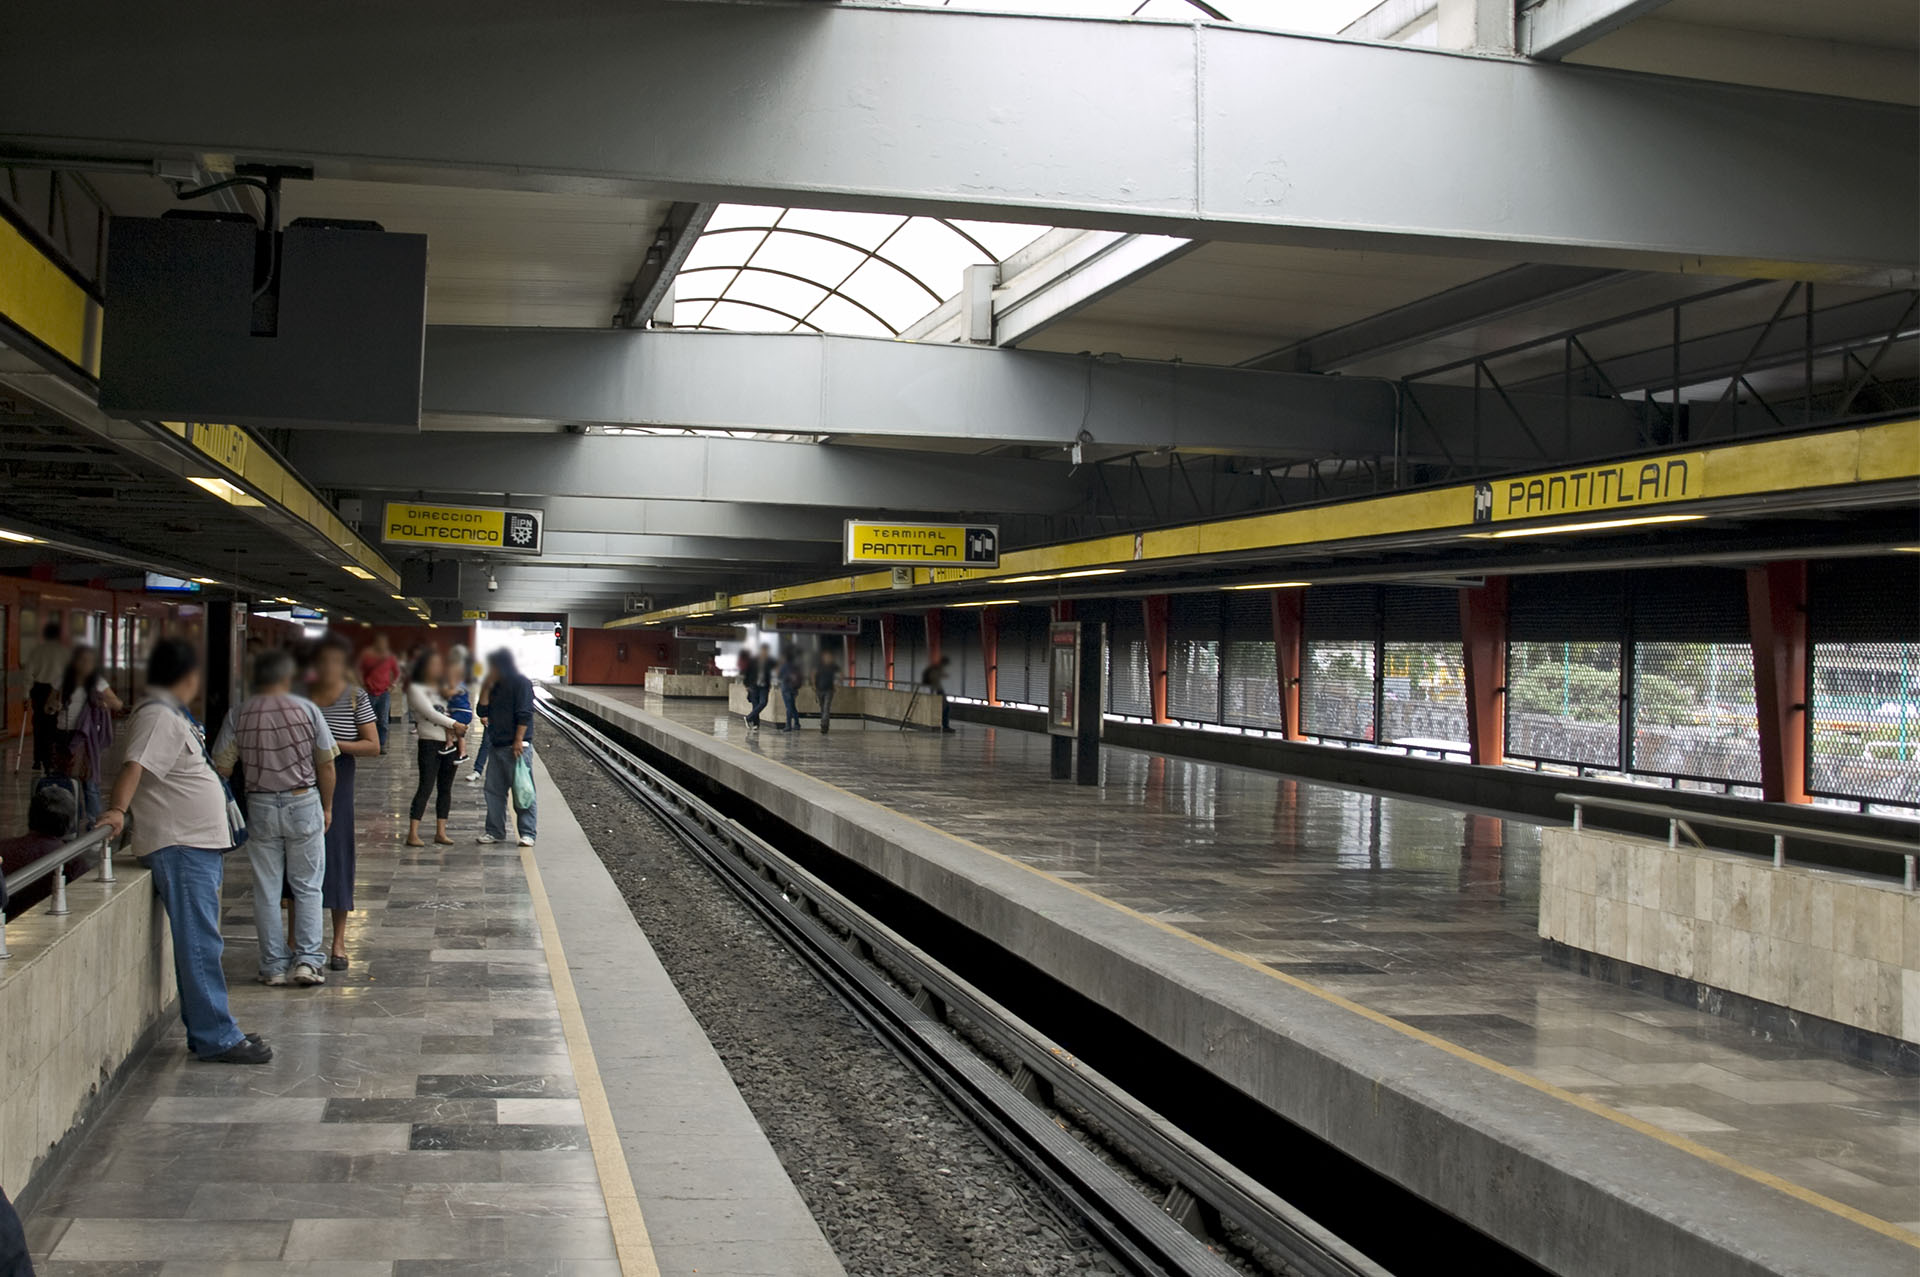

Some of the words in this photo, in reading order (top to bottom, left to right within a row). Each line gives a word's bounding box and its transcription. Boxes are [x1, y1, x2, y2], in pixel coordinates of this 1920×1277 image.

[1508, 460, 1688, 515] PANTITLAN
[408, 510, 482, 523] DIRECCION
[391, 524, 499, 542] POLITECNICO
[873, 529, 946, 540] TERMINAL
[862, 543, 957, 557] PANTITLAN
